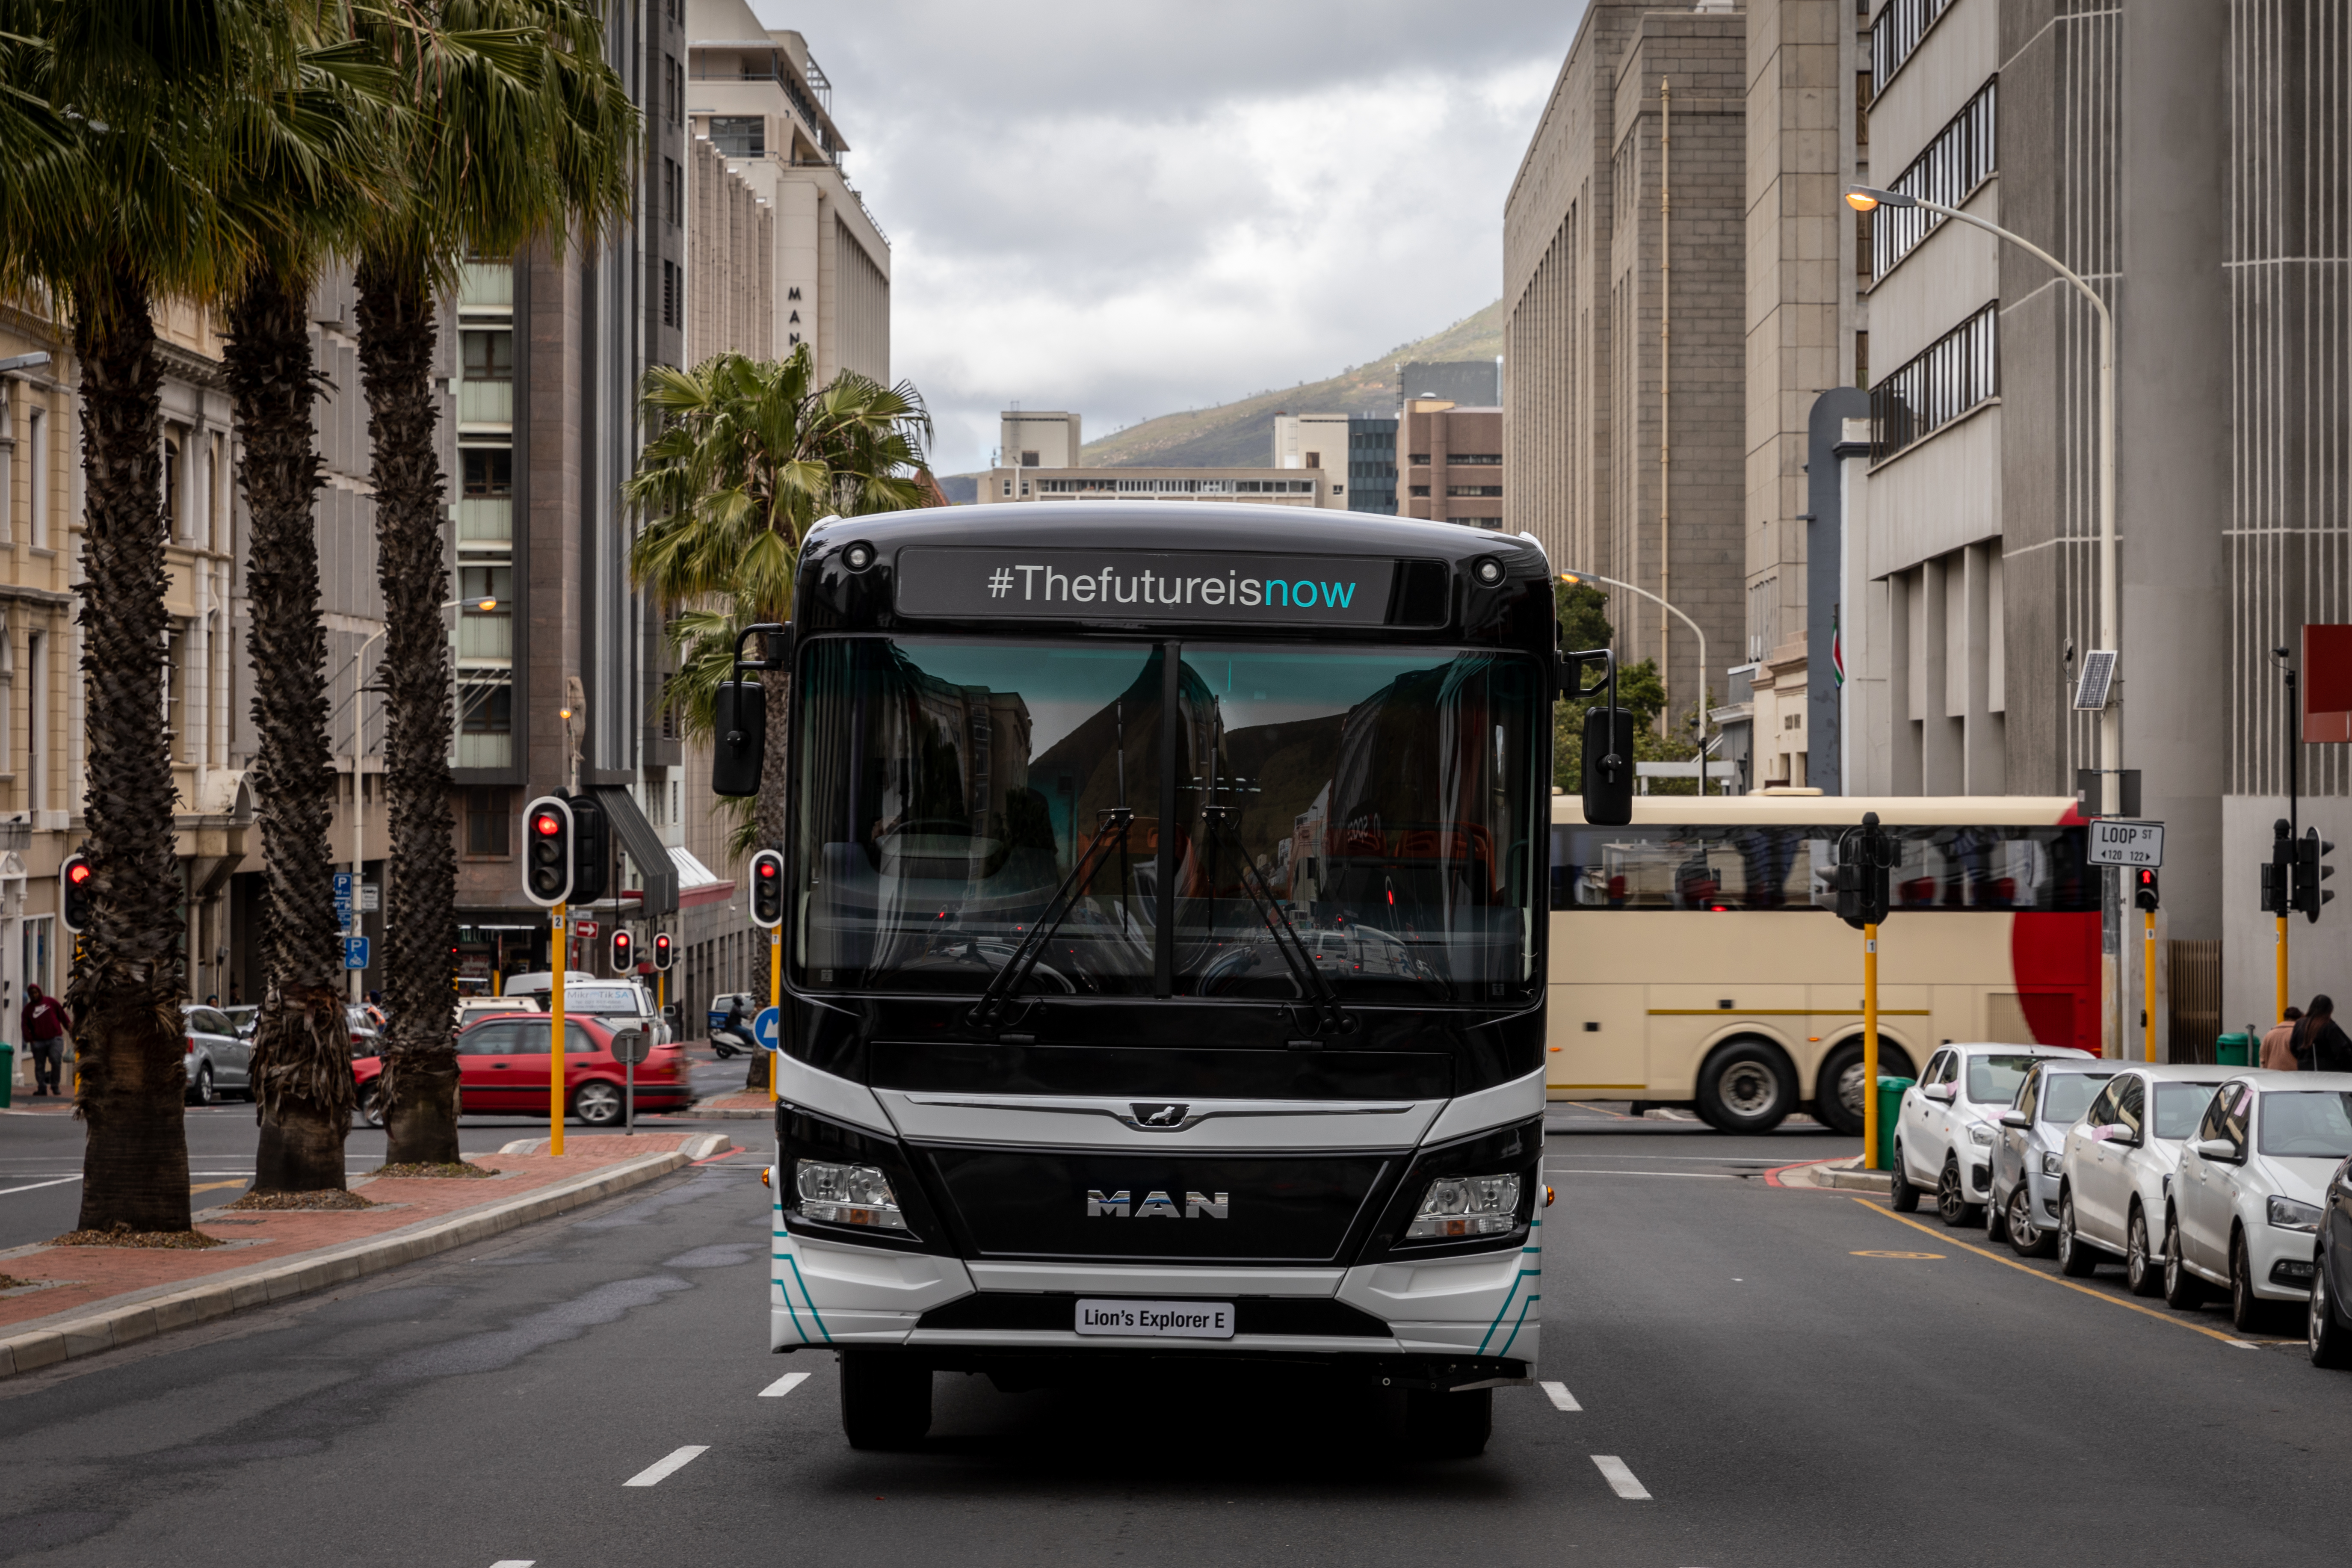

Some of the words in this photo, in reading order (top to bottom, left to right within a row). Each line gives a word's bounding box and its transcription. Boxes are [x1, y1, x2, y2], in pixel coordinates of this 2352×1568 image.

[788, 286, 802, 357] MAN
[987, 565, 1356, 608] #Thefutureisnow
[2102, 827, 2136, 844] LOOP
[2142, 829, 2153, 840] ST
[2108, 850, 2122, 860] 120
[2130, 851, 2144, 861] 122
[338, 877, 347, 888] P
[556, 917, 561, 927] 2
[351, 940, 362, 953] P
[1870, 941, 1874, 952] 1
[1087, 1190, 1228, 1219] MAN
[1085, 1309, 1134, 1326] Lion's
[1139, 1310, 1210, 1331] Explorer
[1215, 1312, 1225, 1328] E
